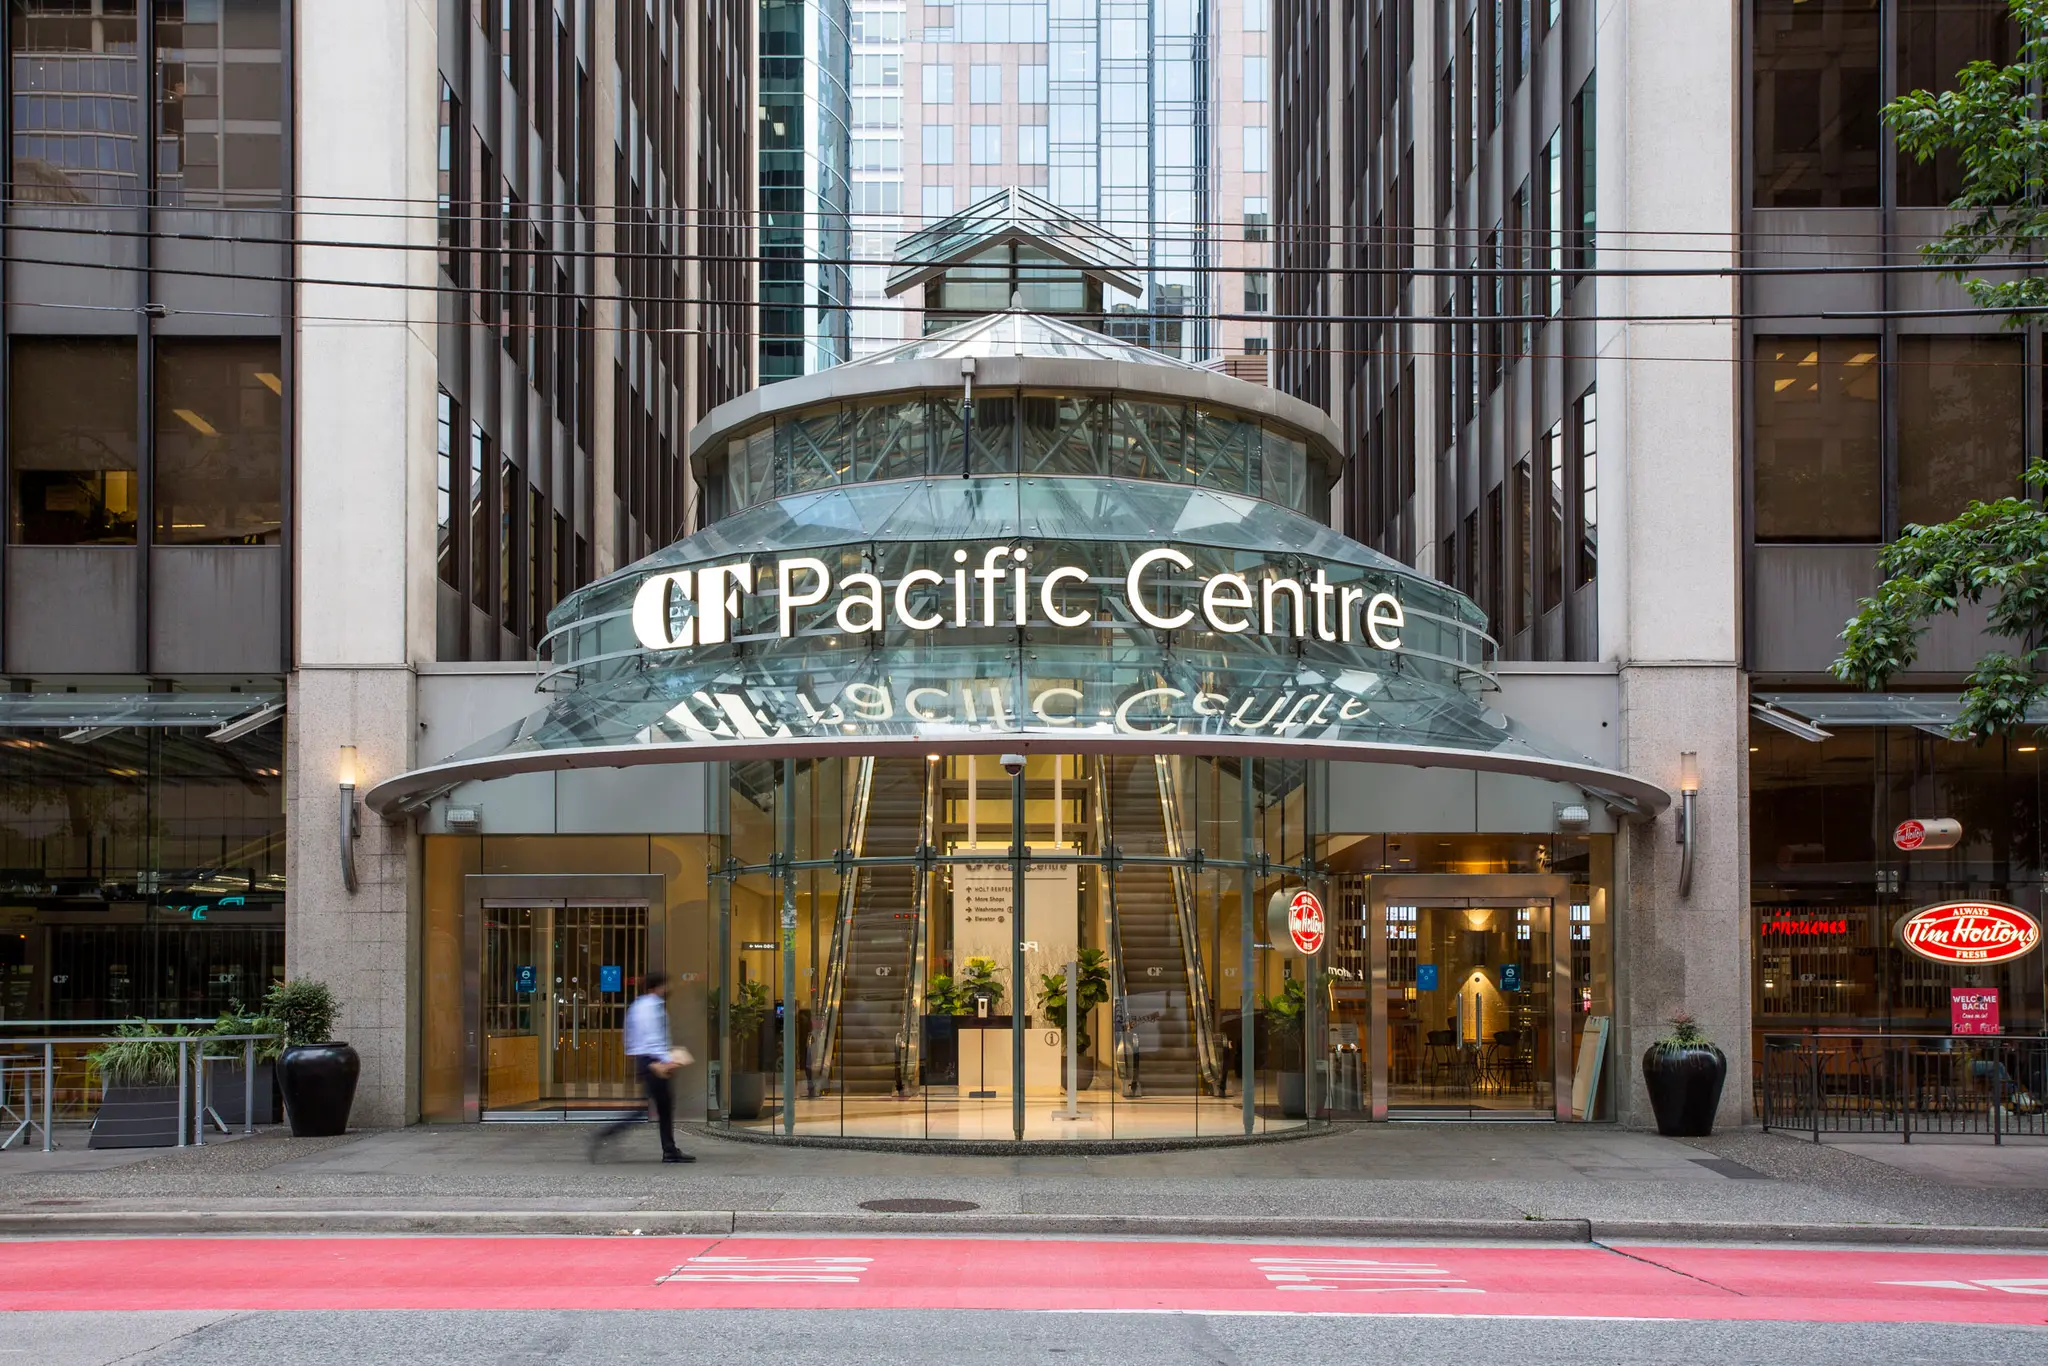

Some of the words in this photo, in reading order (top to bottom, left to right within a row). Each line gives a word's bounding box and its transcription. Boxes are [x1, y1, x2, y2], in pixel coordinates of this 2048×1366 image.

[778, 546, 1092, 637] Pacific
[1126, 547, 1405, 650] Centre
[1953, 907, 1989, 916] ALWAYS
[1908, 918, 1949, 943] Tim
[1951, 916, 2035, 946] Hortons
[1956, 950, 1987, 958] FRESH
[1962, 1002, 1988, 1010] BACK!
